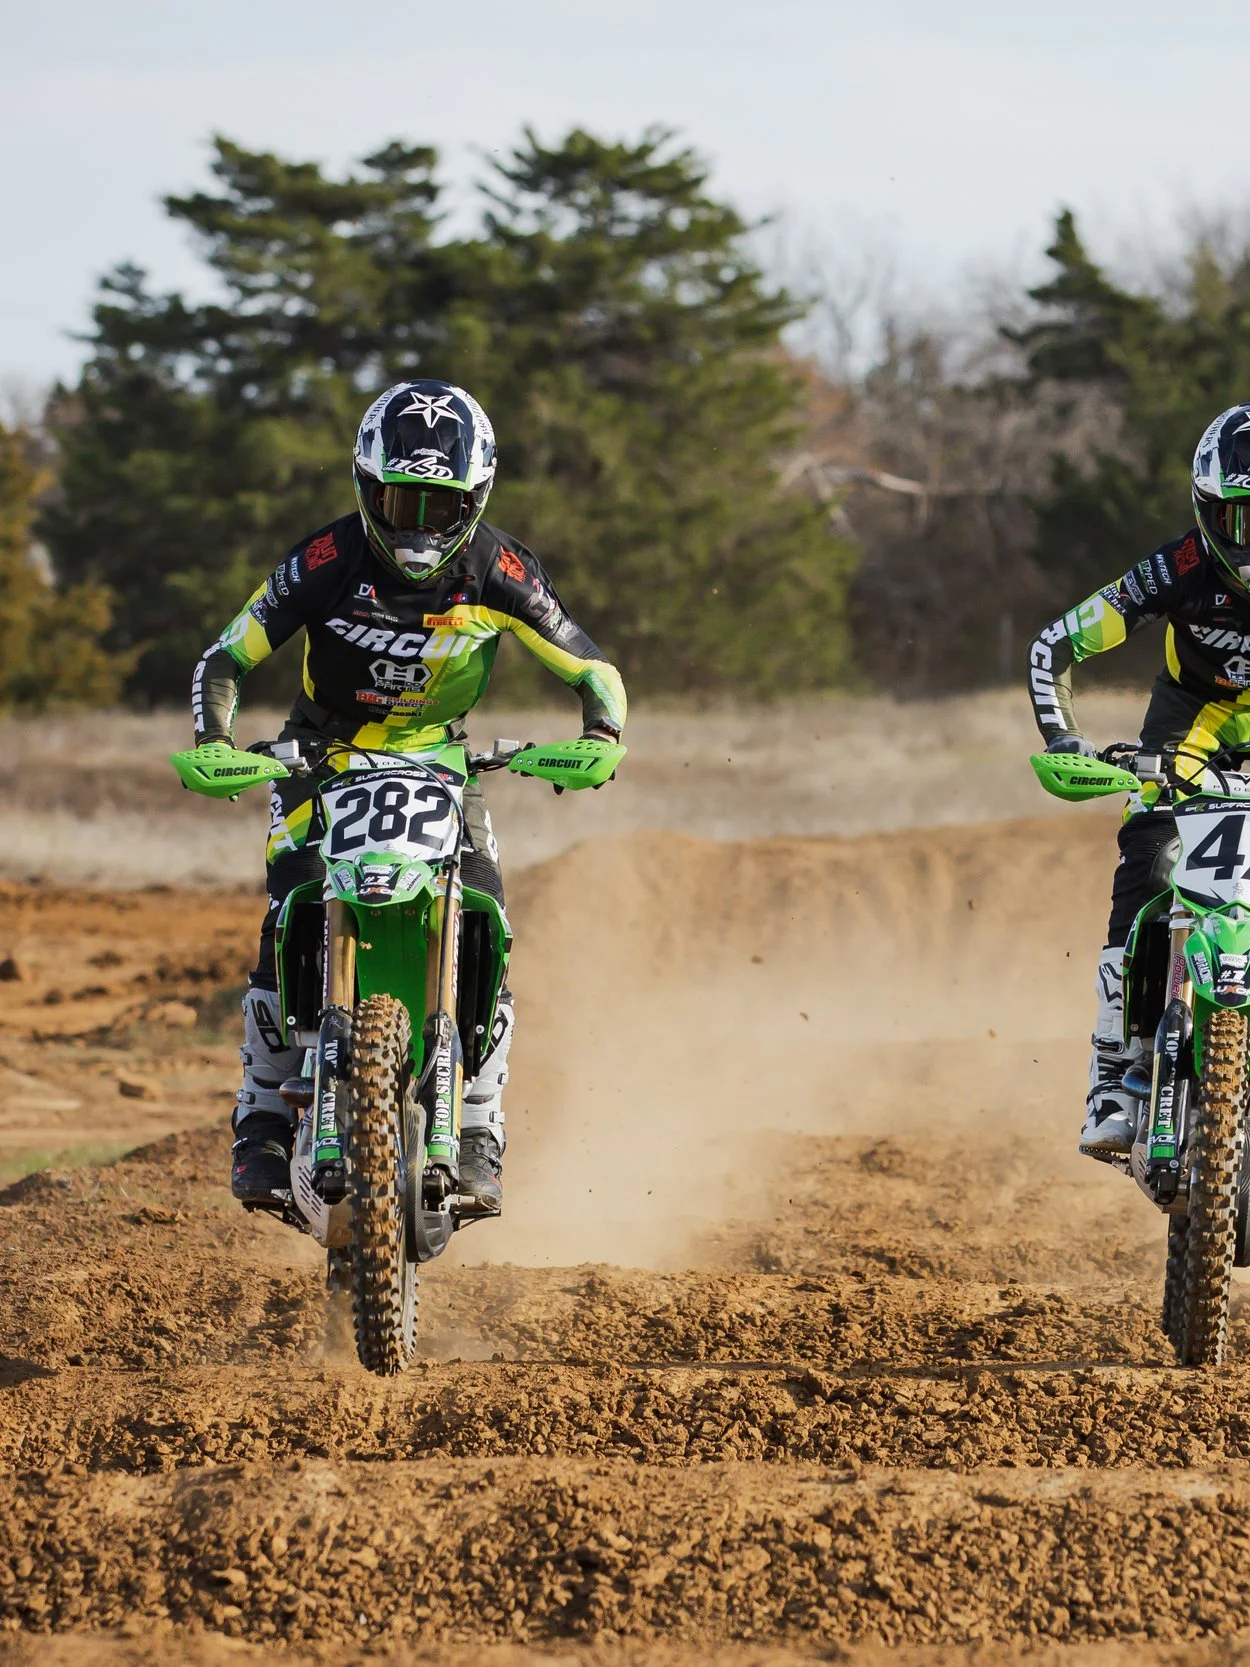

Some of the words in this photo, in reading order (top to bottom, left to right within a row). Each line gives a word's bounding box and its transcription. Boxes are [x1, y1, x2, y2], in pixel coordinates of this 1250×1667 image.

[426, 617, 463, 627] PIRELLI
[1031, 594, 1105, 731] CIRCUIT
[537, 758, 583, 769] CIRCUIT
[213, 766, 260, 777] CIRCUIT
[355, 769, 428, 783] SUPERCROSS
[1069, 776, 1114, 786] CIRCUIT
[331, 781, 451, 856] 282
[351, 886, 401, 897] LUXON
[1220, 970, 1246, 980] #1
[436, 1042, 451, 1095] SECRE
[435, 1097, 450, 1129] TOP
[313, 1138, 341, 1148] VOL
[1149, 1134, 1176, 1144] EVOL
